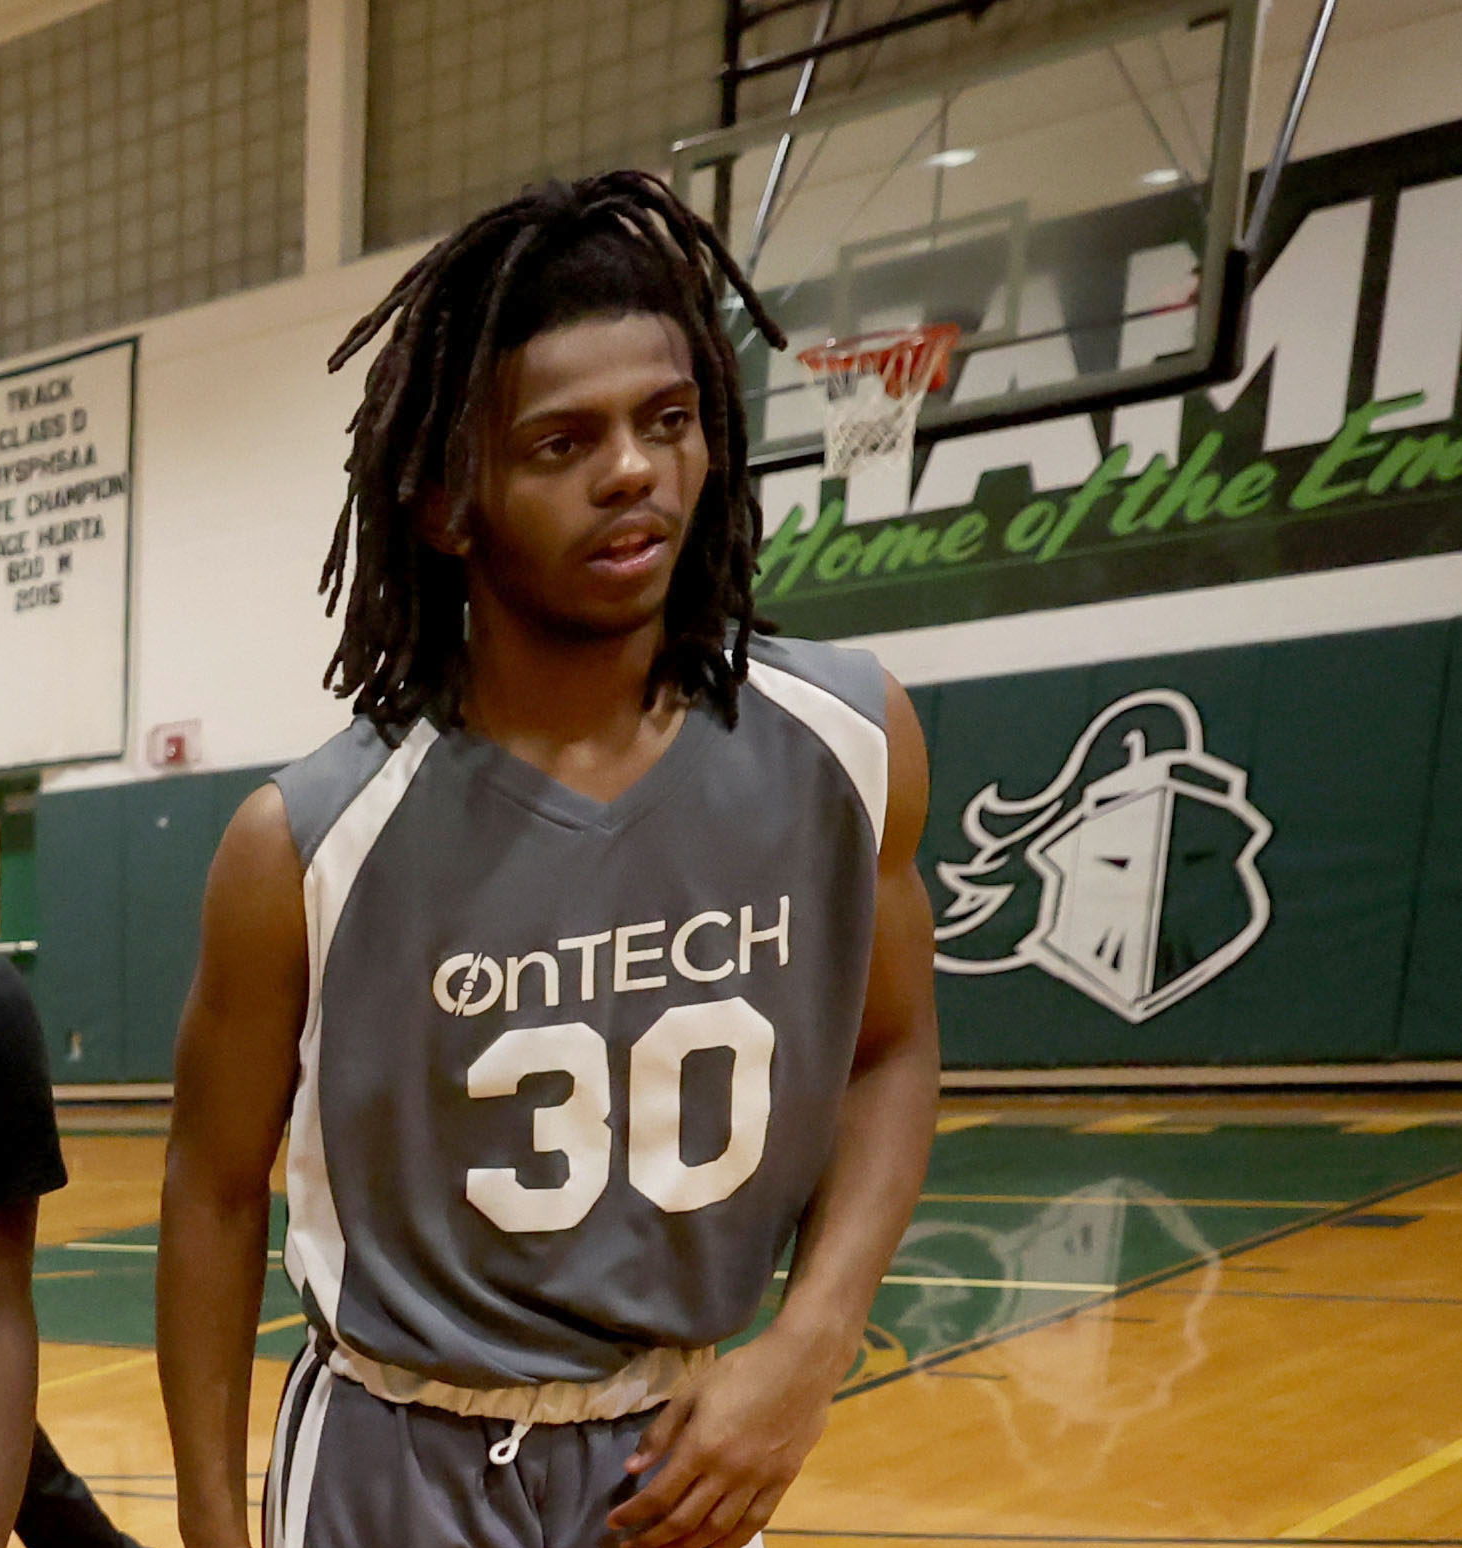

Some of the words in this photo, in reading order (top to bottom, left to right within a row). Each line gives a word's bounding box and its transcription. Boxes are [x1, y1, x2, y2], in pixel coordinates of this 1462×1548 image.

[6, 376, 74, 412] TRACK
[754, 500, 988, 593] Home
[1004, 443, 1132, 561] of
[1108, 431, 1279, 537] the
[465, 996, 776, 1233] 30
